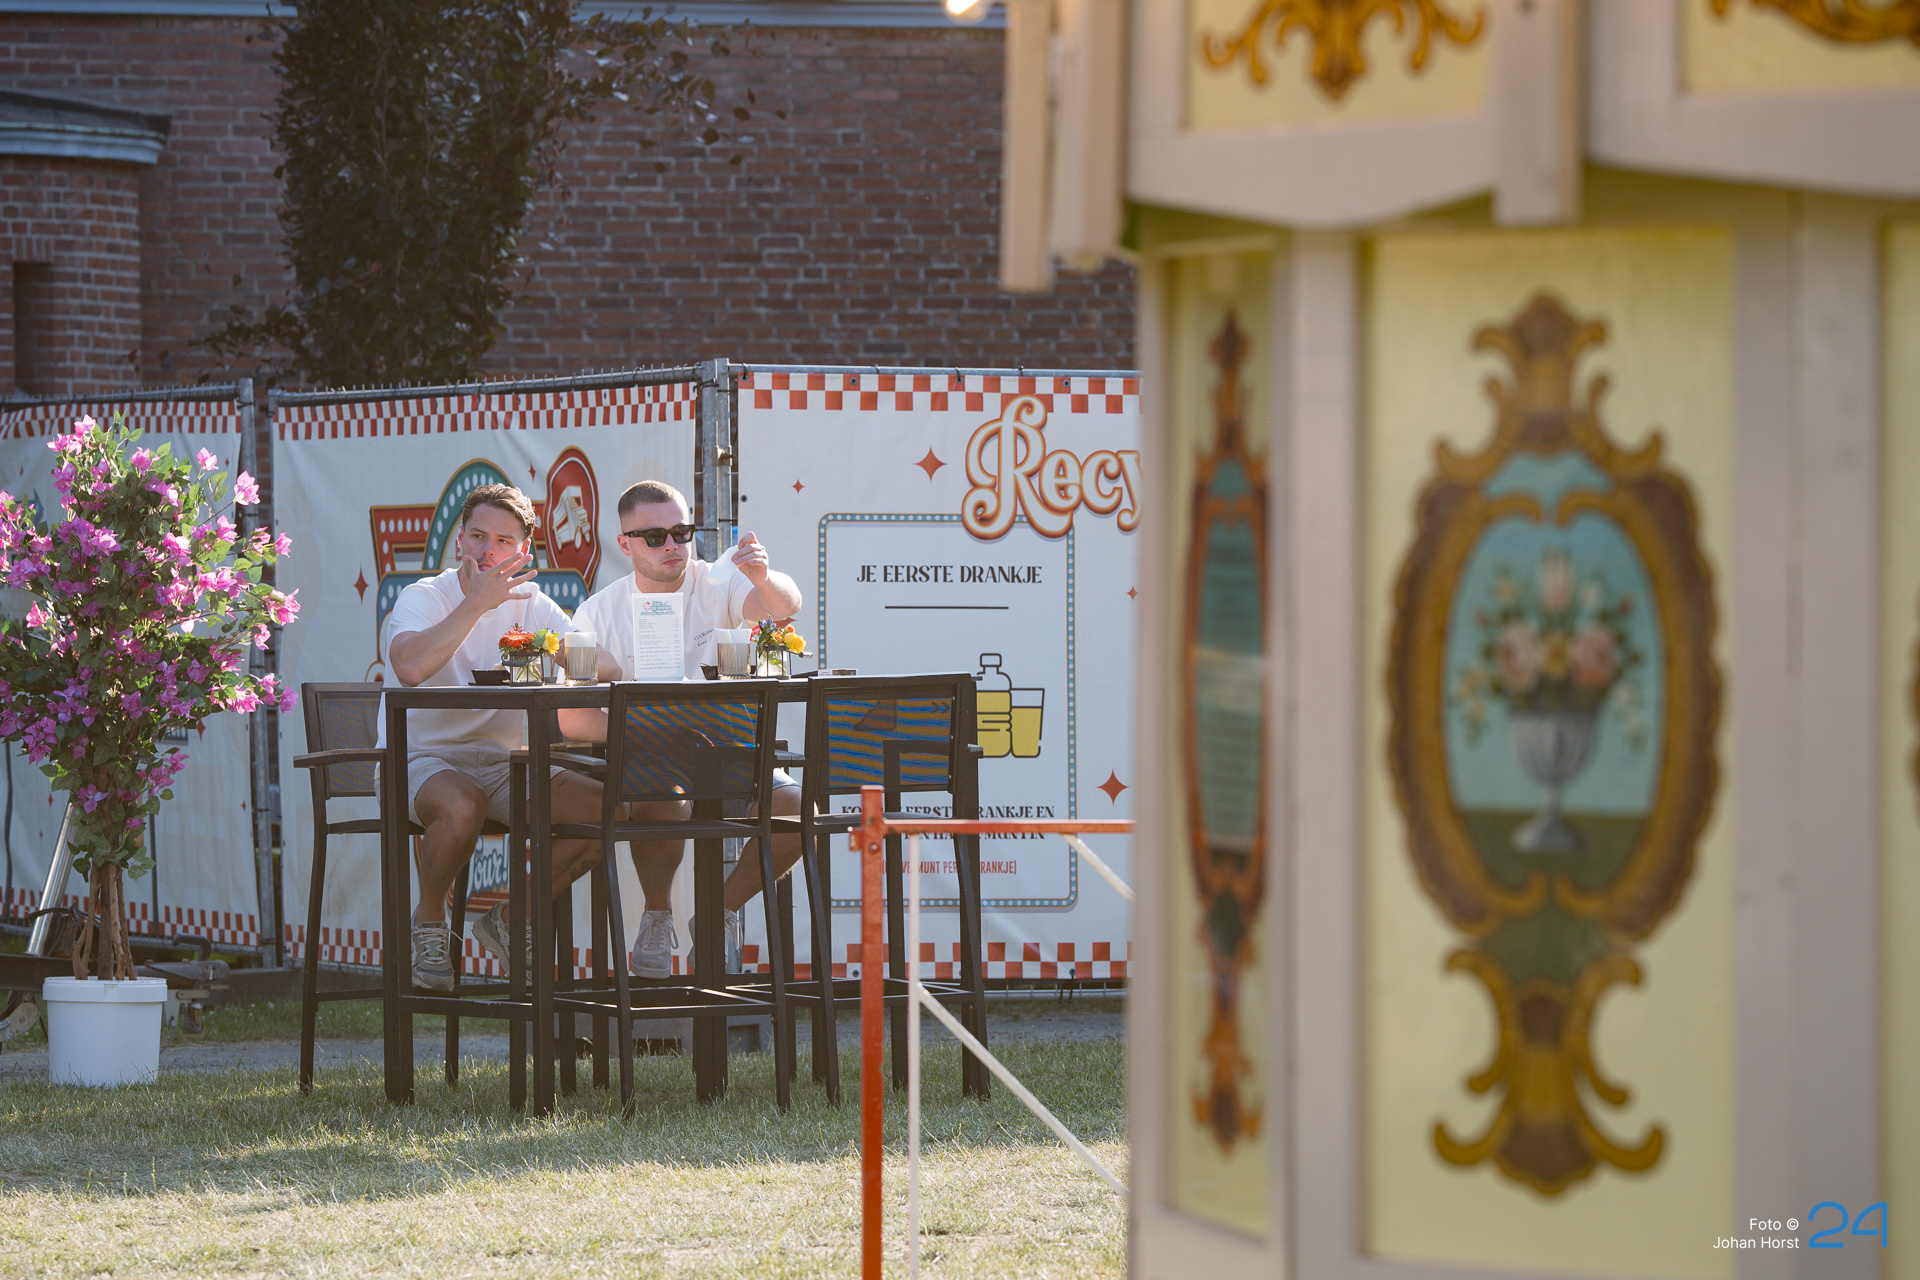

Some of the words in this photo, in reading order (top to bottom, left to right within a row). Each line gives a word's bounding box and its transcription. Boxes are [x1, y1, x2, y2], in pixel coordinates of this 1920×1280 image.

[856, 565, 877, 583] JE
[883, 565, 953, 583] EERSTE
[960, 565, 1042, 584] DRANKJE
[906, 805, 955, 818] EERST
[978, 805, 1033, 818] RANKJE
[1036, 805, 1055, 818] EN
[980, 860, 1017, 875] RANKJE)
